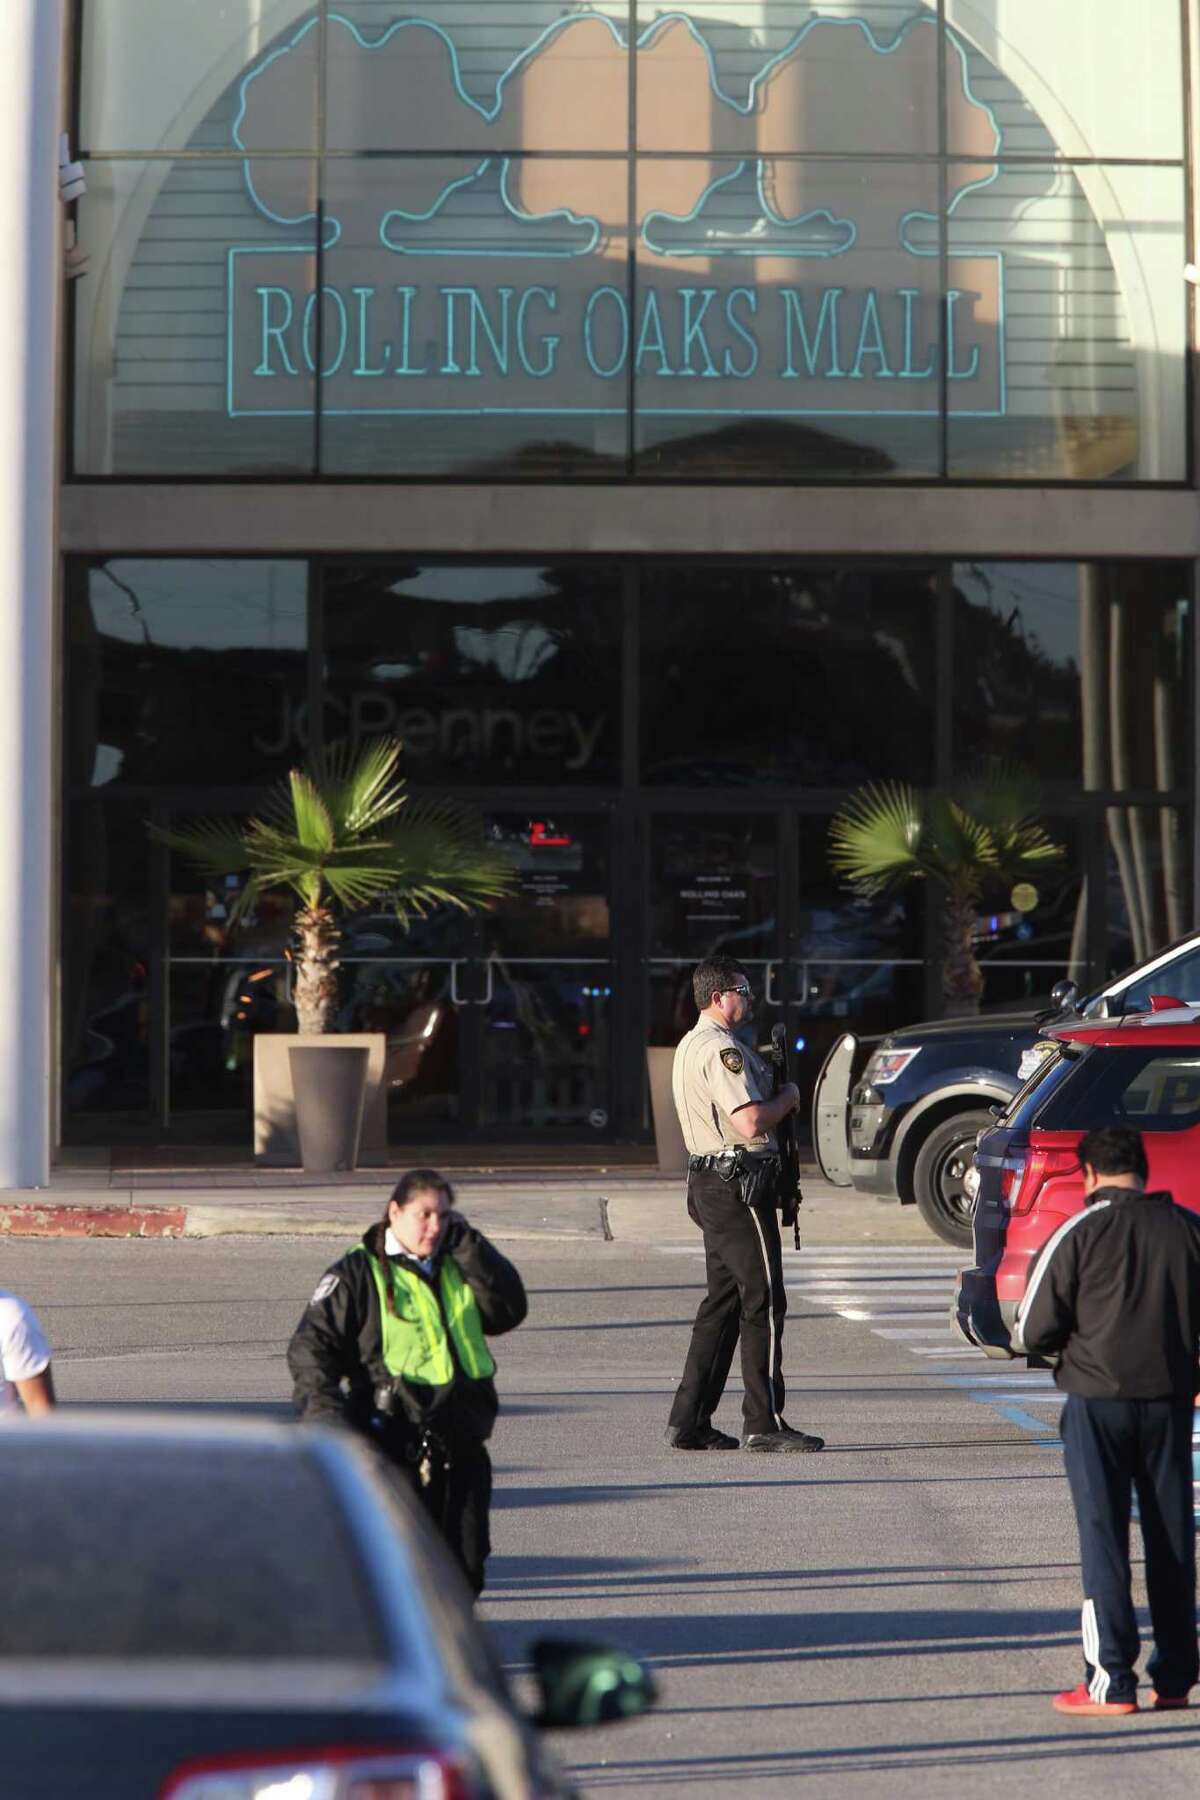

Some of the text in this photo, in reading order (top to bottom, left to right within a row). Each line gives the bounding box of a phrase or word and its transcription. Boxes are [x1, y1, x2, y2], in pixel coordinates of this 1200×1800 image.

[253, 285, 979, 379] ROLLING OAKS MALL
